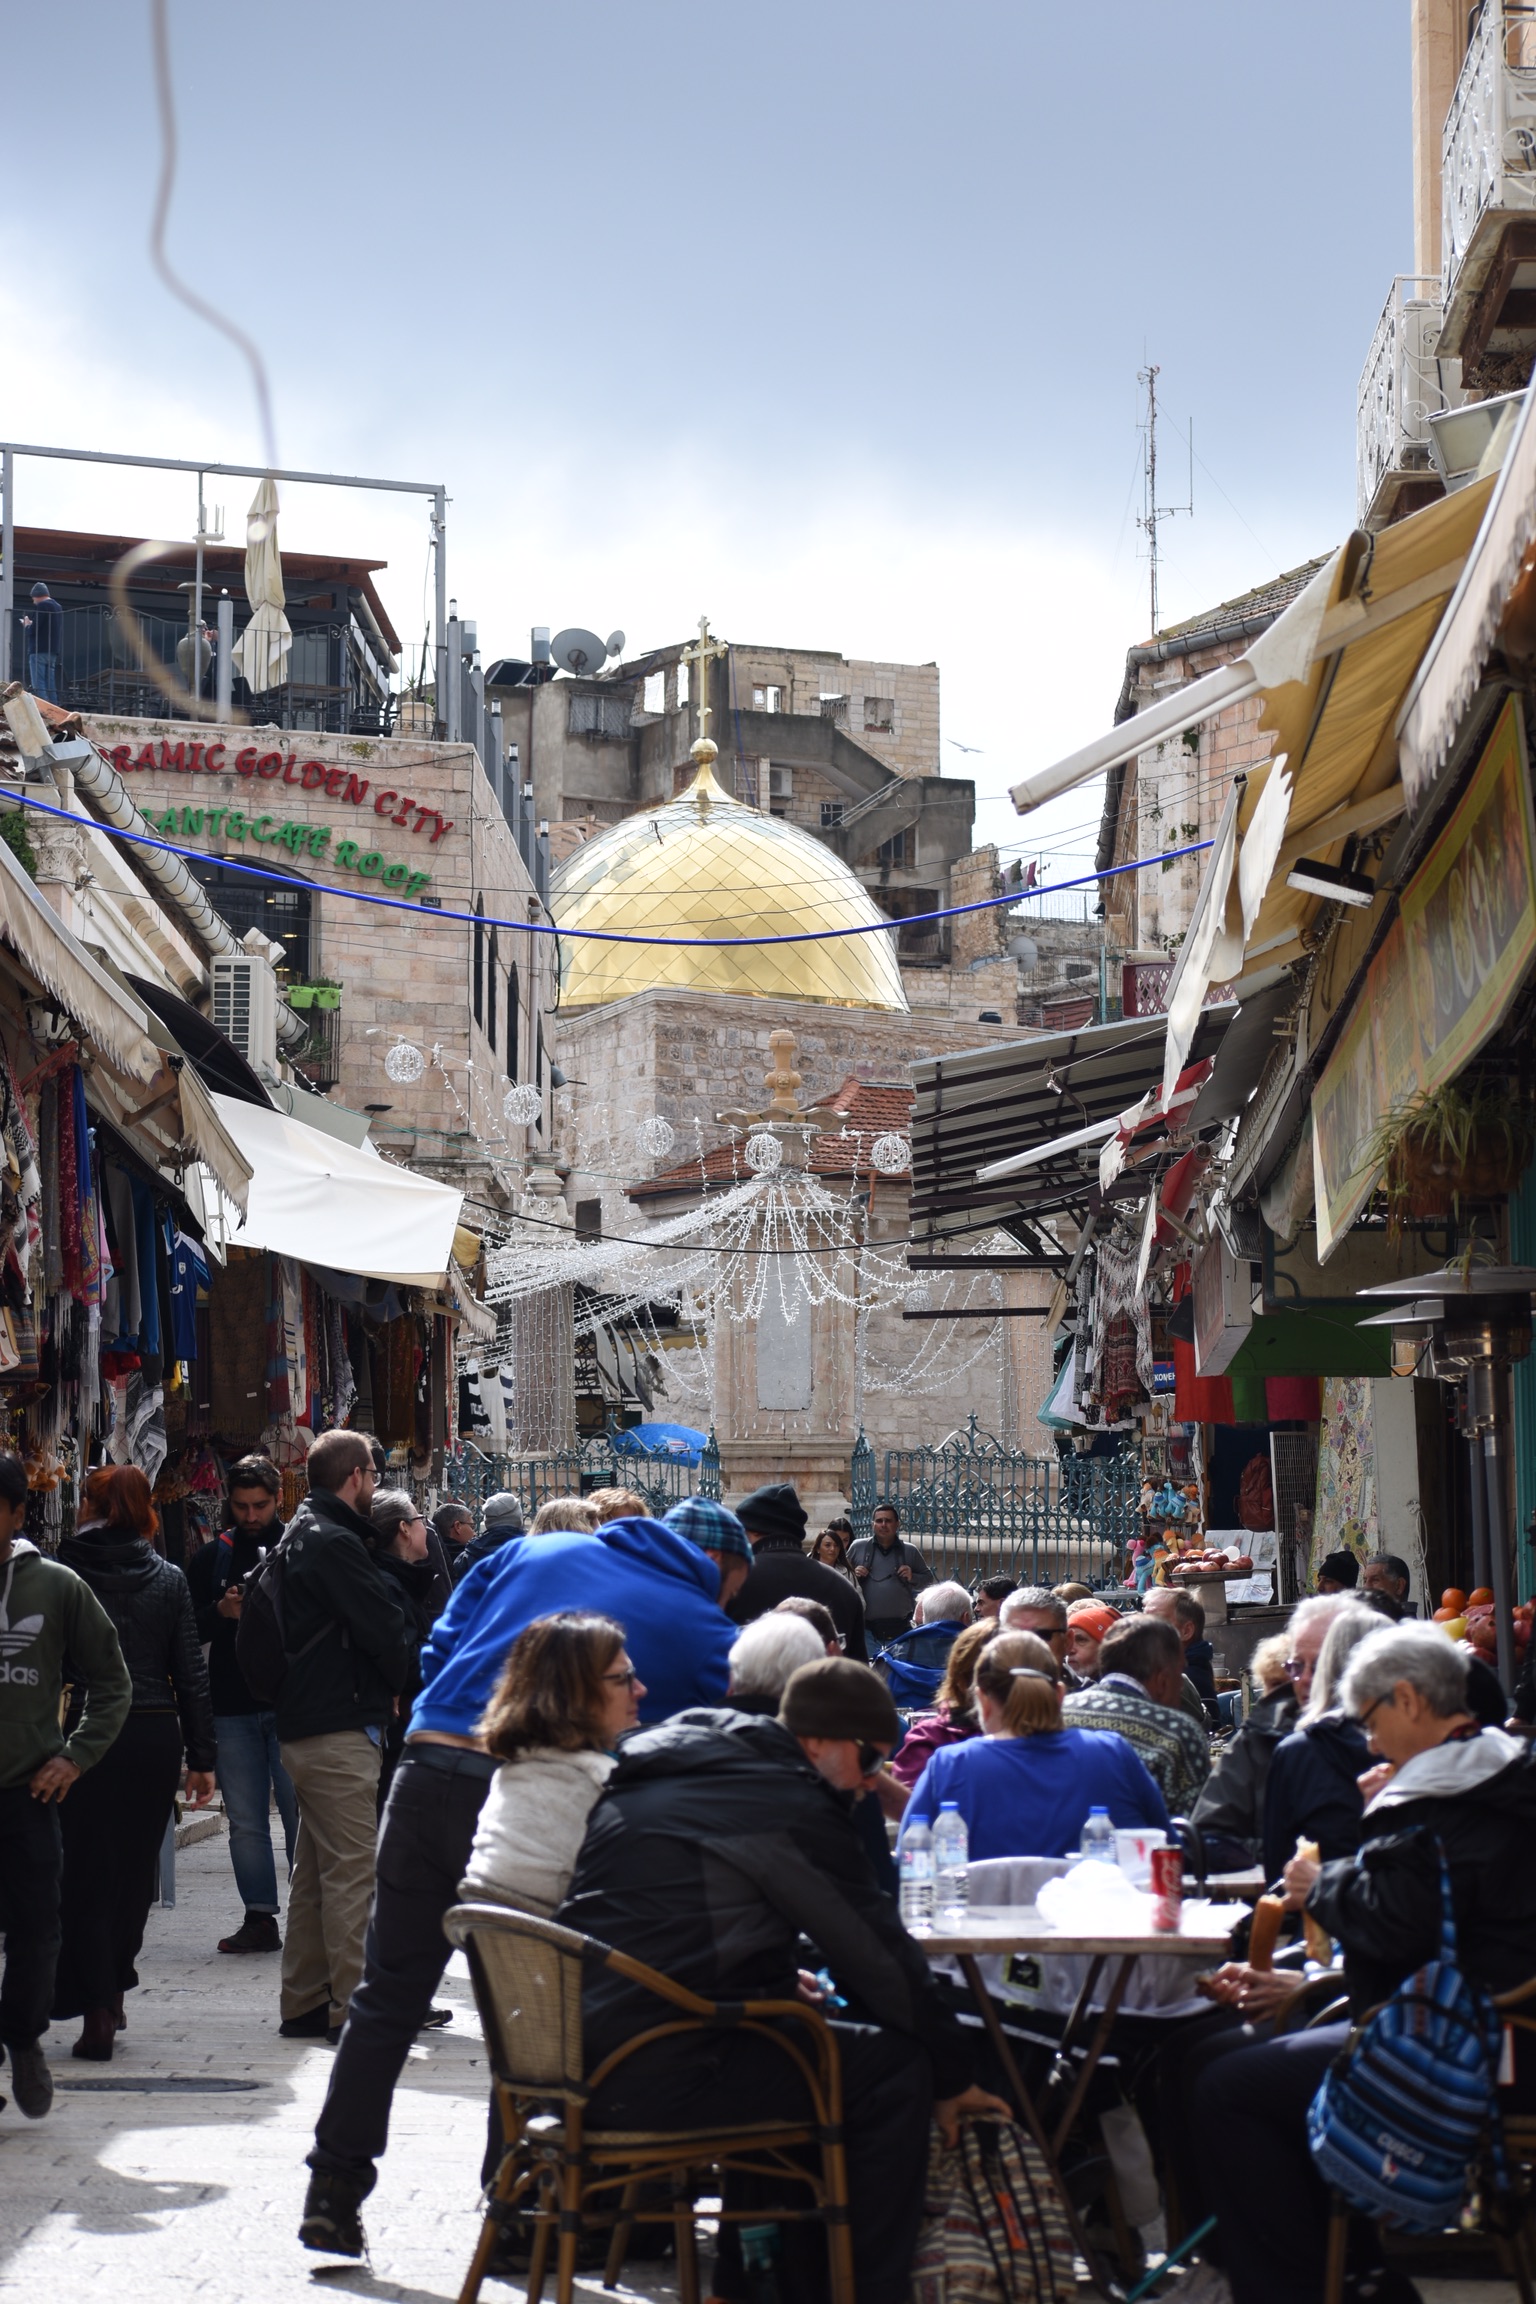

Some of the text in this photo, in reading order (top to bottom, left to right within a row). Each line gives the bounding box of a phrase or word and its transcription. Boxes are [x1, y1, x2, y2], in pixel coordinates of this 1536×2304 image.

[98, 740, 454, 842] RAMIC GOLDEN CITY
[333, 841, 432, 898] ROOF
